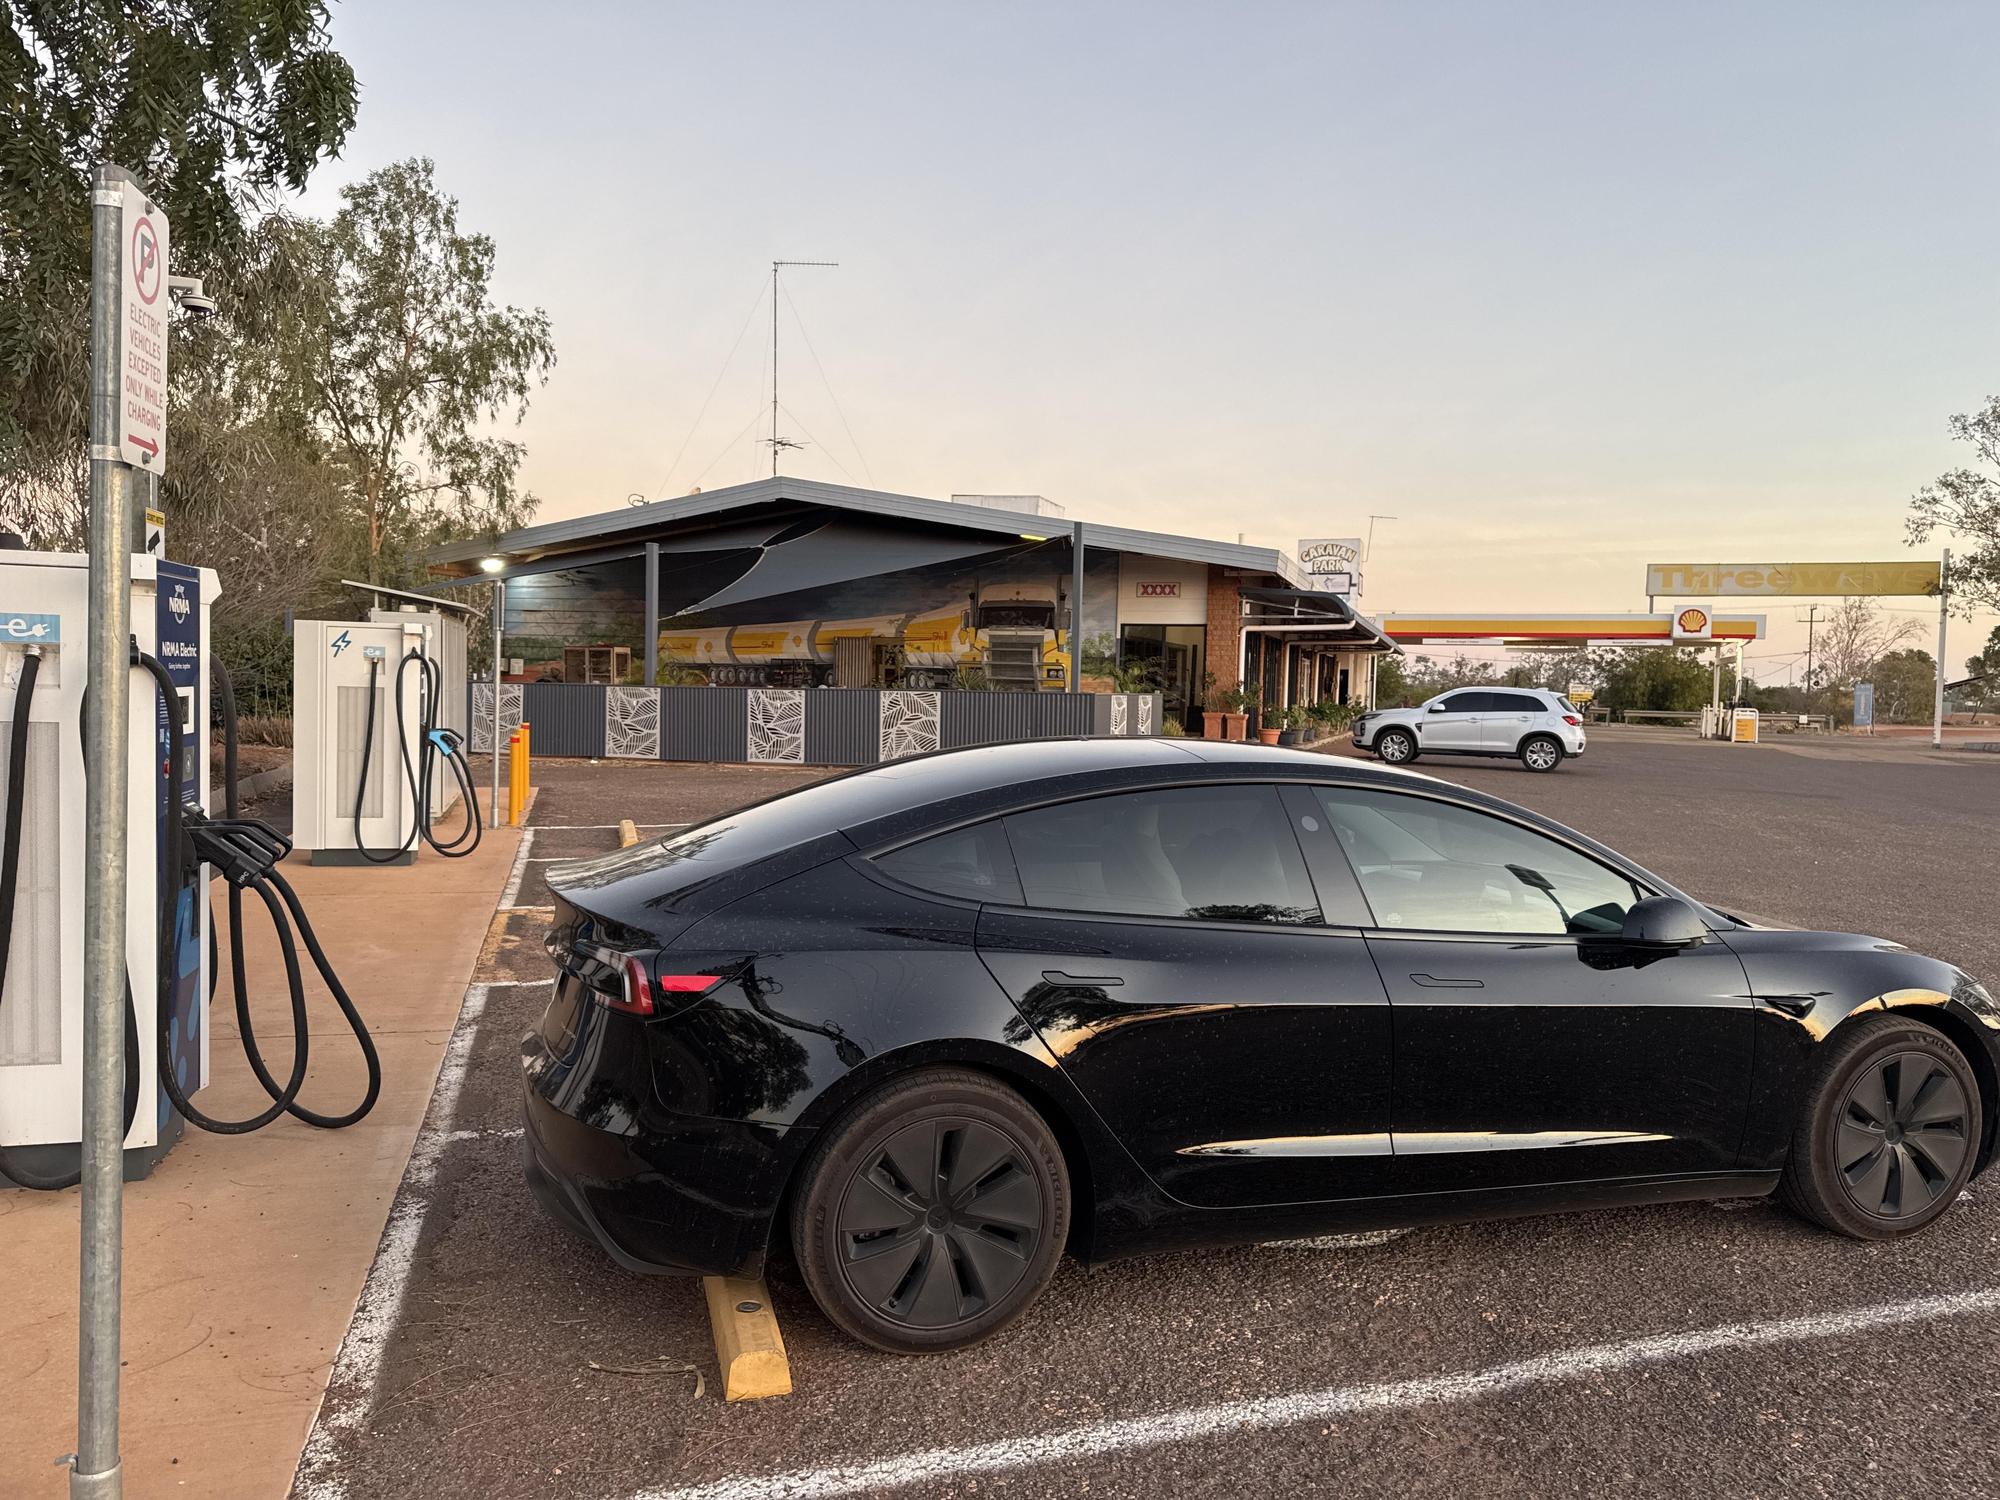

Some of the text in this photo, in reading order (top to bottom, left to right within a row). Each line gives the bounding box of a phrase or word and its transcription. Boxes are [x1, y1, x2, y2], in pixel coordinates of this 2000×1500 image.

[130, 303, 161, 338] ELECTRIC
[129, 326, 161, 361] VEHICLES
[128, 351, 161, 384] EXCEPTED
[125, 375, 164, 410] ONLY WHILE
[127, 401, 161, 431] CHARGING
[1301, 543, 1357, 562] CARAVAN
[1312, 560, 1344, 572] PARK
[1141, 584, 1176, 596] XXXX
[1653, 566, 1938, 594] Threeways
[168, 596, 190, 615] NRMA
[161, 641, 197, 657] NRMA Electric
